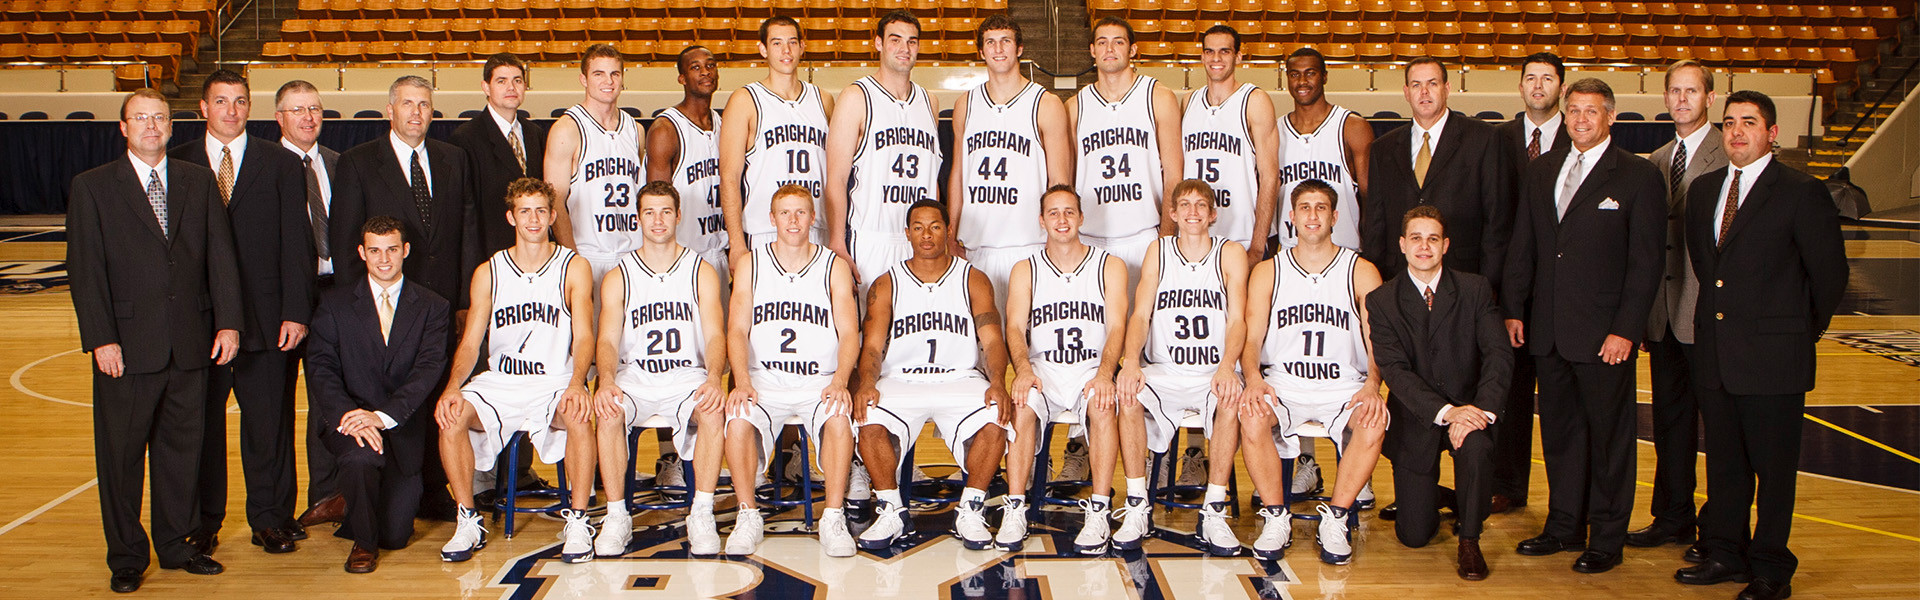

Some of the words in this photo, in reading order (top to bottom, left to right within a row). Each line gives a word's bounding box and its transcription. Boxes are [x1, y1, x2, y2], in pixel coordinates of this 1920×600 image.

[764, 124, 827, 150] BRIGHAM
[875, 126, 935, 154] BRIGHAM
[967, 130, 1031, 157] BRIGHAM
[1082, 126, 1149, 156] BRIGHAM
[585, 157, 640, 185] BRIGHAM
[686, 158, 720, 185] BRIGH
[786, 149, 811, 173] 10
[892, 153, 919, 179] 43
[978, 156, 1008, 181] 44
[1101, 153, 1131, 179] 34
[1196, 158, 1220, 183] 15
[604, 183, 630, 207] 23
[883, 185, 927, 204] YOUNG
[968, 185, 1018, 205] YOUNG
[1093, 182, 1142, 205] YOUNG
[594, 213, 638, 232] YOUNG
[1157, 288, 1223, 311] BRIGHAM
[495, 302, 560, 329] BRIGHAM
[754, 301, 828, 329] BRIGHAM
[894, 311, 968, 339] BRIGHAM
[1032, 301, 1105, 328] BRIGHAM
[1175, 314, 1209, 340] 30
[1277, 303, 1350, 331] BRIGHAM
[647, 328, 682, 356] 20
[780, 327, 797, 354] 2
[926, 339, 937, 363] 1
[1054, 327, 1084, 350] 13
[1302, 330, 1325, 357] 11
[498, 353, 546, 375] YOUNG
[1166, 344, 1220, 365] YOUNG
[1283, 361, 1340, 380] YOUNG
